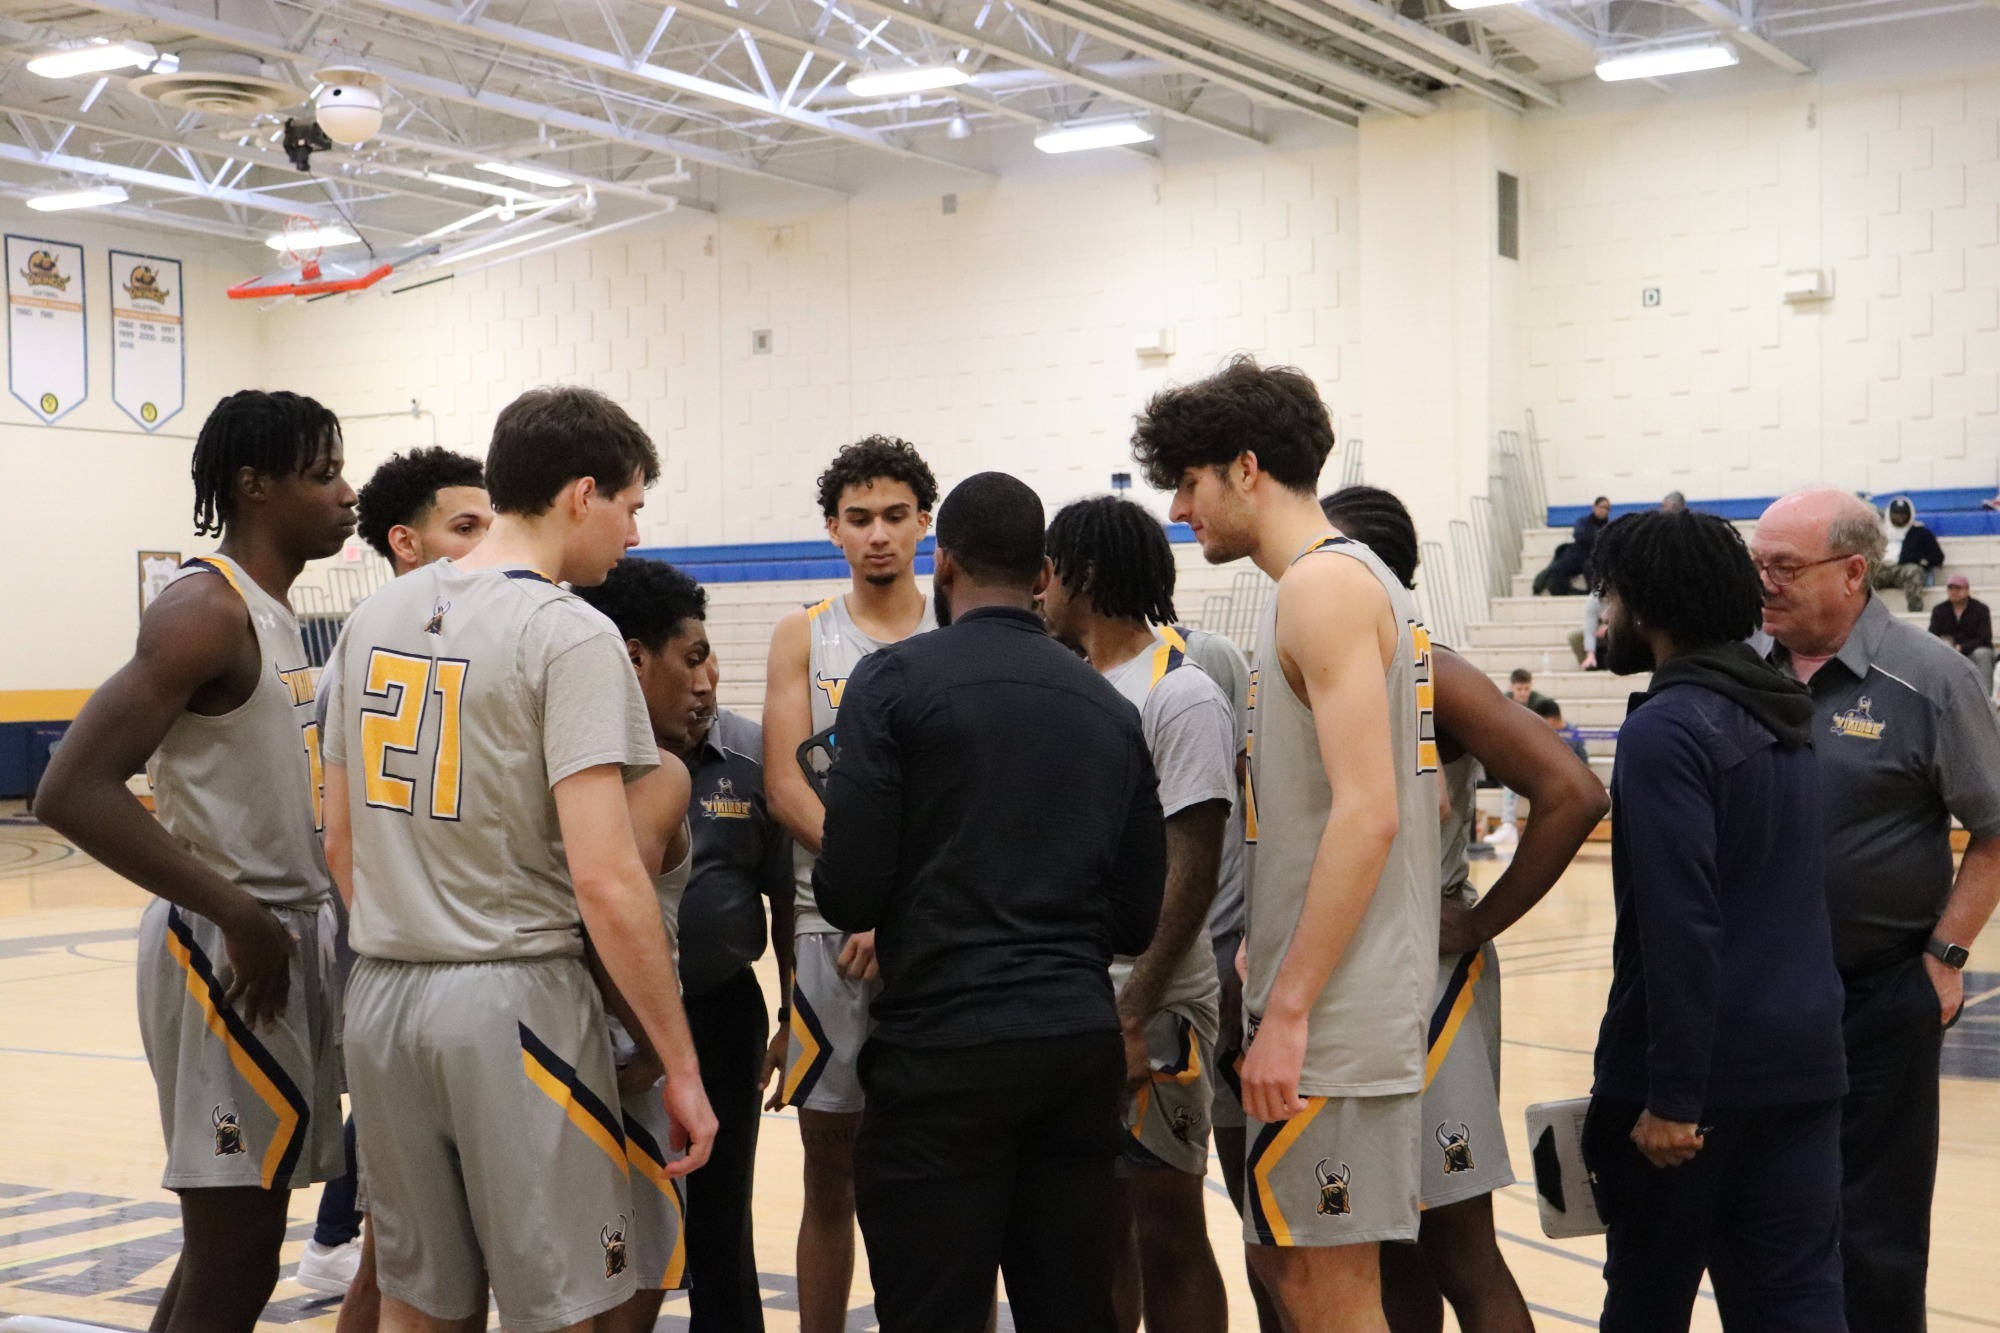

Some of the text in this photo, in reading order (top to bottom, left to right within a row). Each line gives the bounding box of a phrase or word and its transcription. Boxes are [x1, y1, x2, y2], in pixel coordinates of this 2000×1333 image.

[1645, 289, 1659, 306] D
[360, 646, 470, 822] 21
[1833, 713, 1885, 737] VIKINGS
[700, 798, 752, 815] VIKINGS
